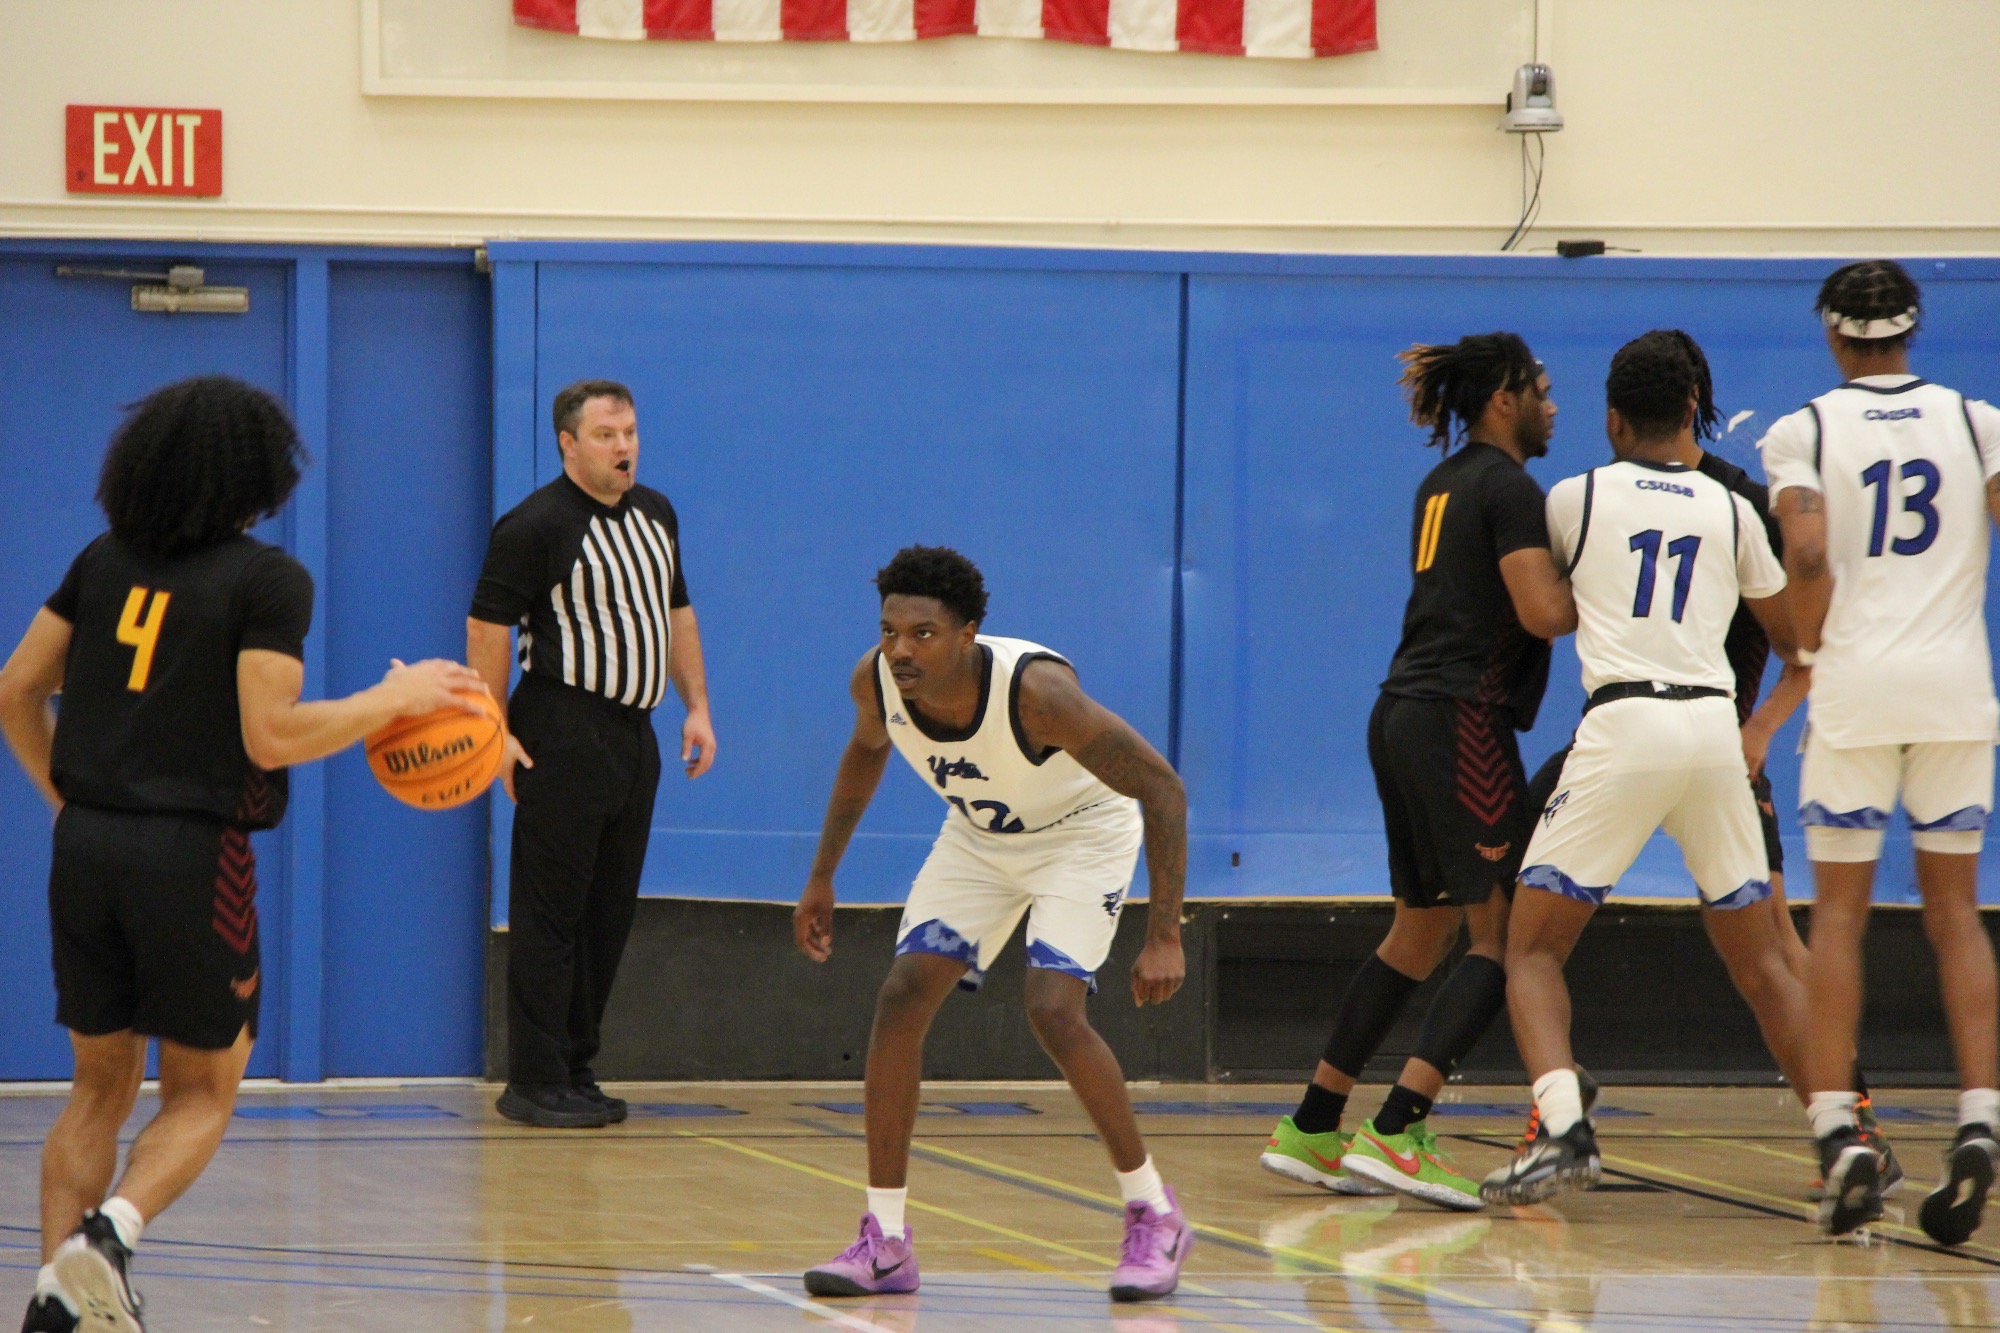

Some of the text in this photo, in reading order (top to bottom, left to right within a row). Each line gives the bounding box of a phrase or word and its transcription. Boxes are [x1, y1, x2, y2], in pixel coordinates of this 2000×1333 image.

[93, 111, 202, 187] EXIT
[1635, 478, 1695, 498] CSUSB
[1861, 458, 1941, 557] 13
[1416, 492, 1450, 572] 11
[1629, 529, 1702, 624] 11
[116, 585, 172, 692] 4
[384, 734, 474, 775] Wilson
